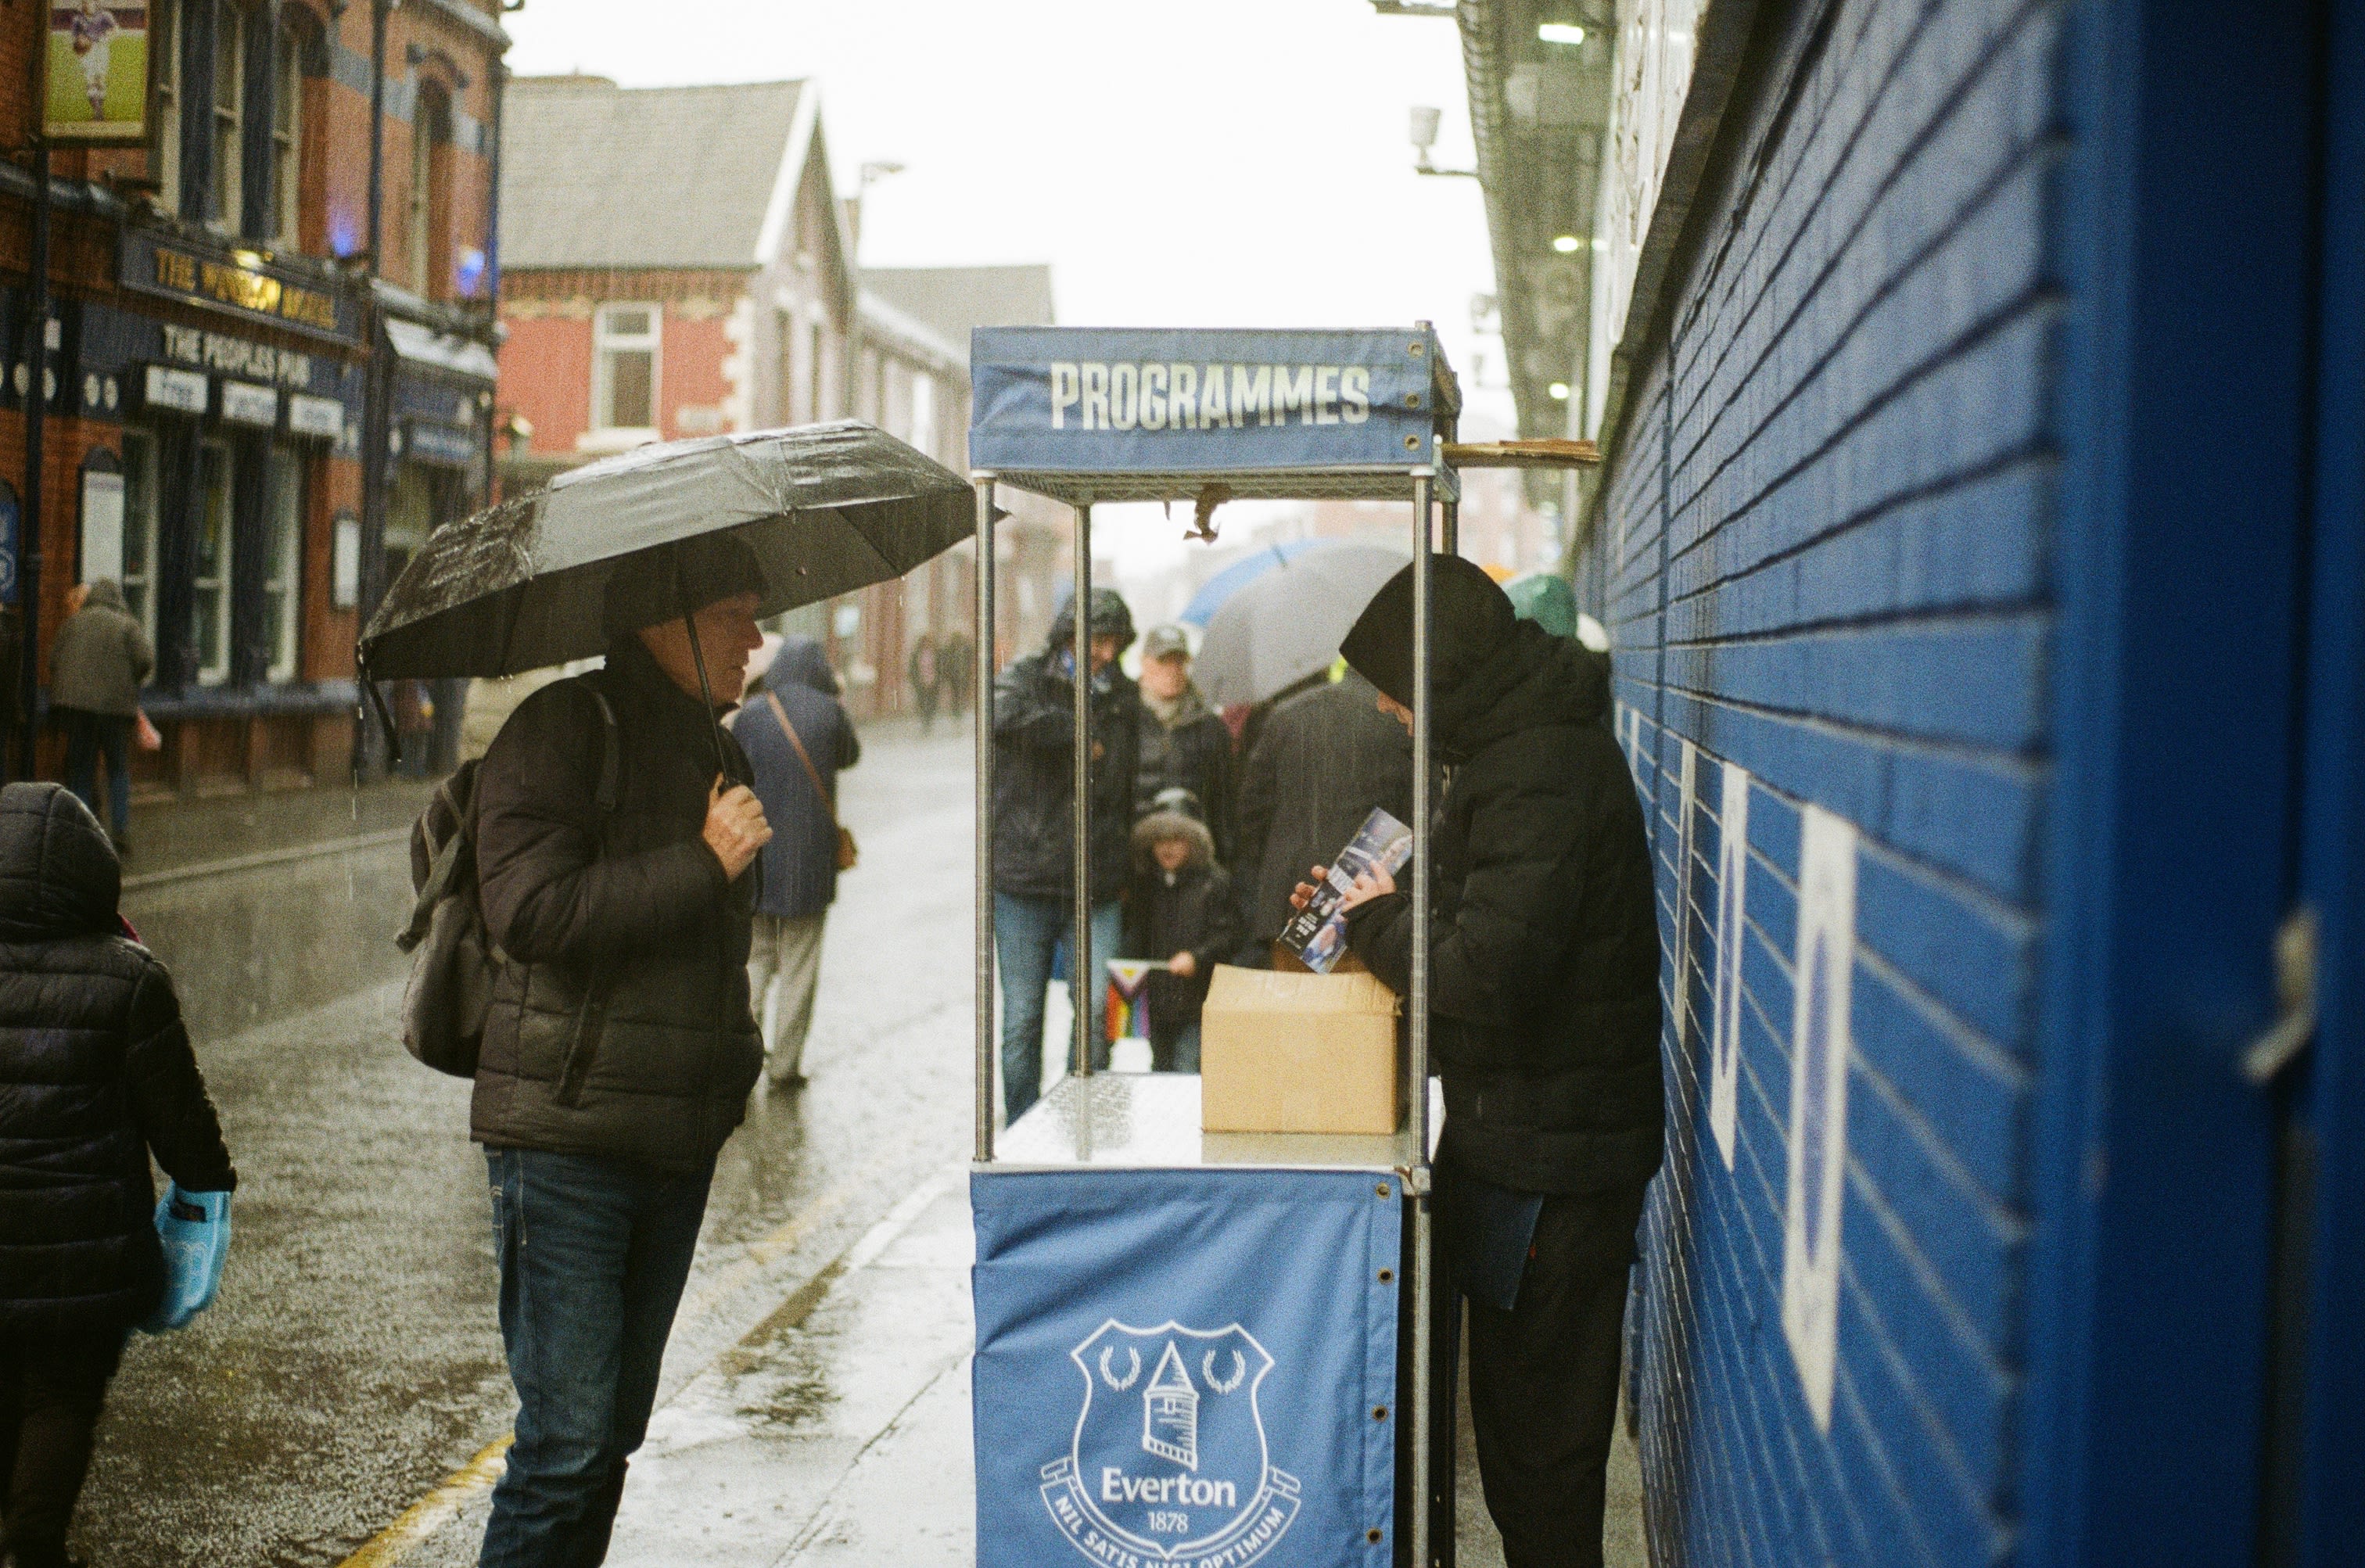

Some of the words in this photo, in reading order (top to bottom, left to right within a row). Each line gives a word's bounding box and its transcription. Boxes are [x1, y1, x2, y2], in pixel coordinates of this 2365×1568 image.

[156, 249, 196, 292] THE
[164, 324, 200, 364] THE
[1051, 362, 1370, 431] PROGRAMMES
[1102, 1468, 1236, 1508] Everton
[1055, 1496, 1085, 1534] NIL
[1084, 1530, 1139, 1568] SATIS
[1200, 1506, 1285, 1568] OPTIMUM
[1147, 1511, 1188, 1534] 1878
